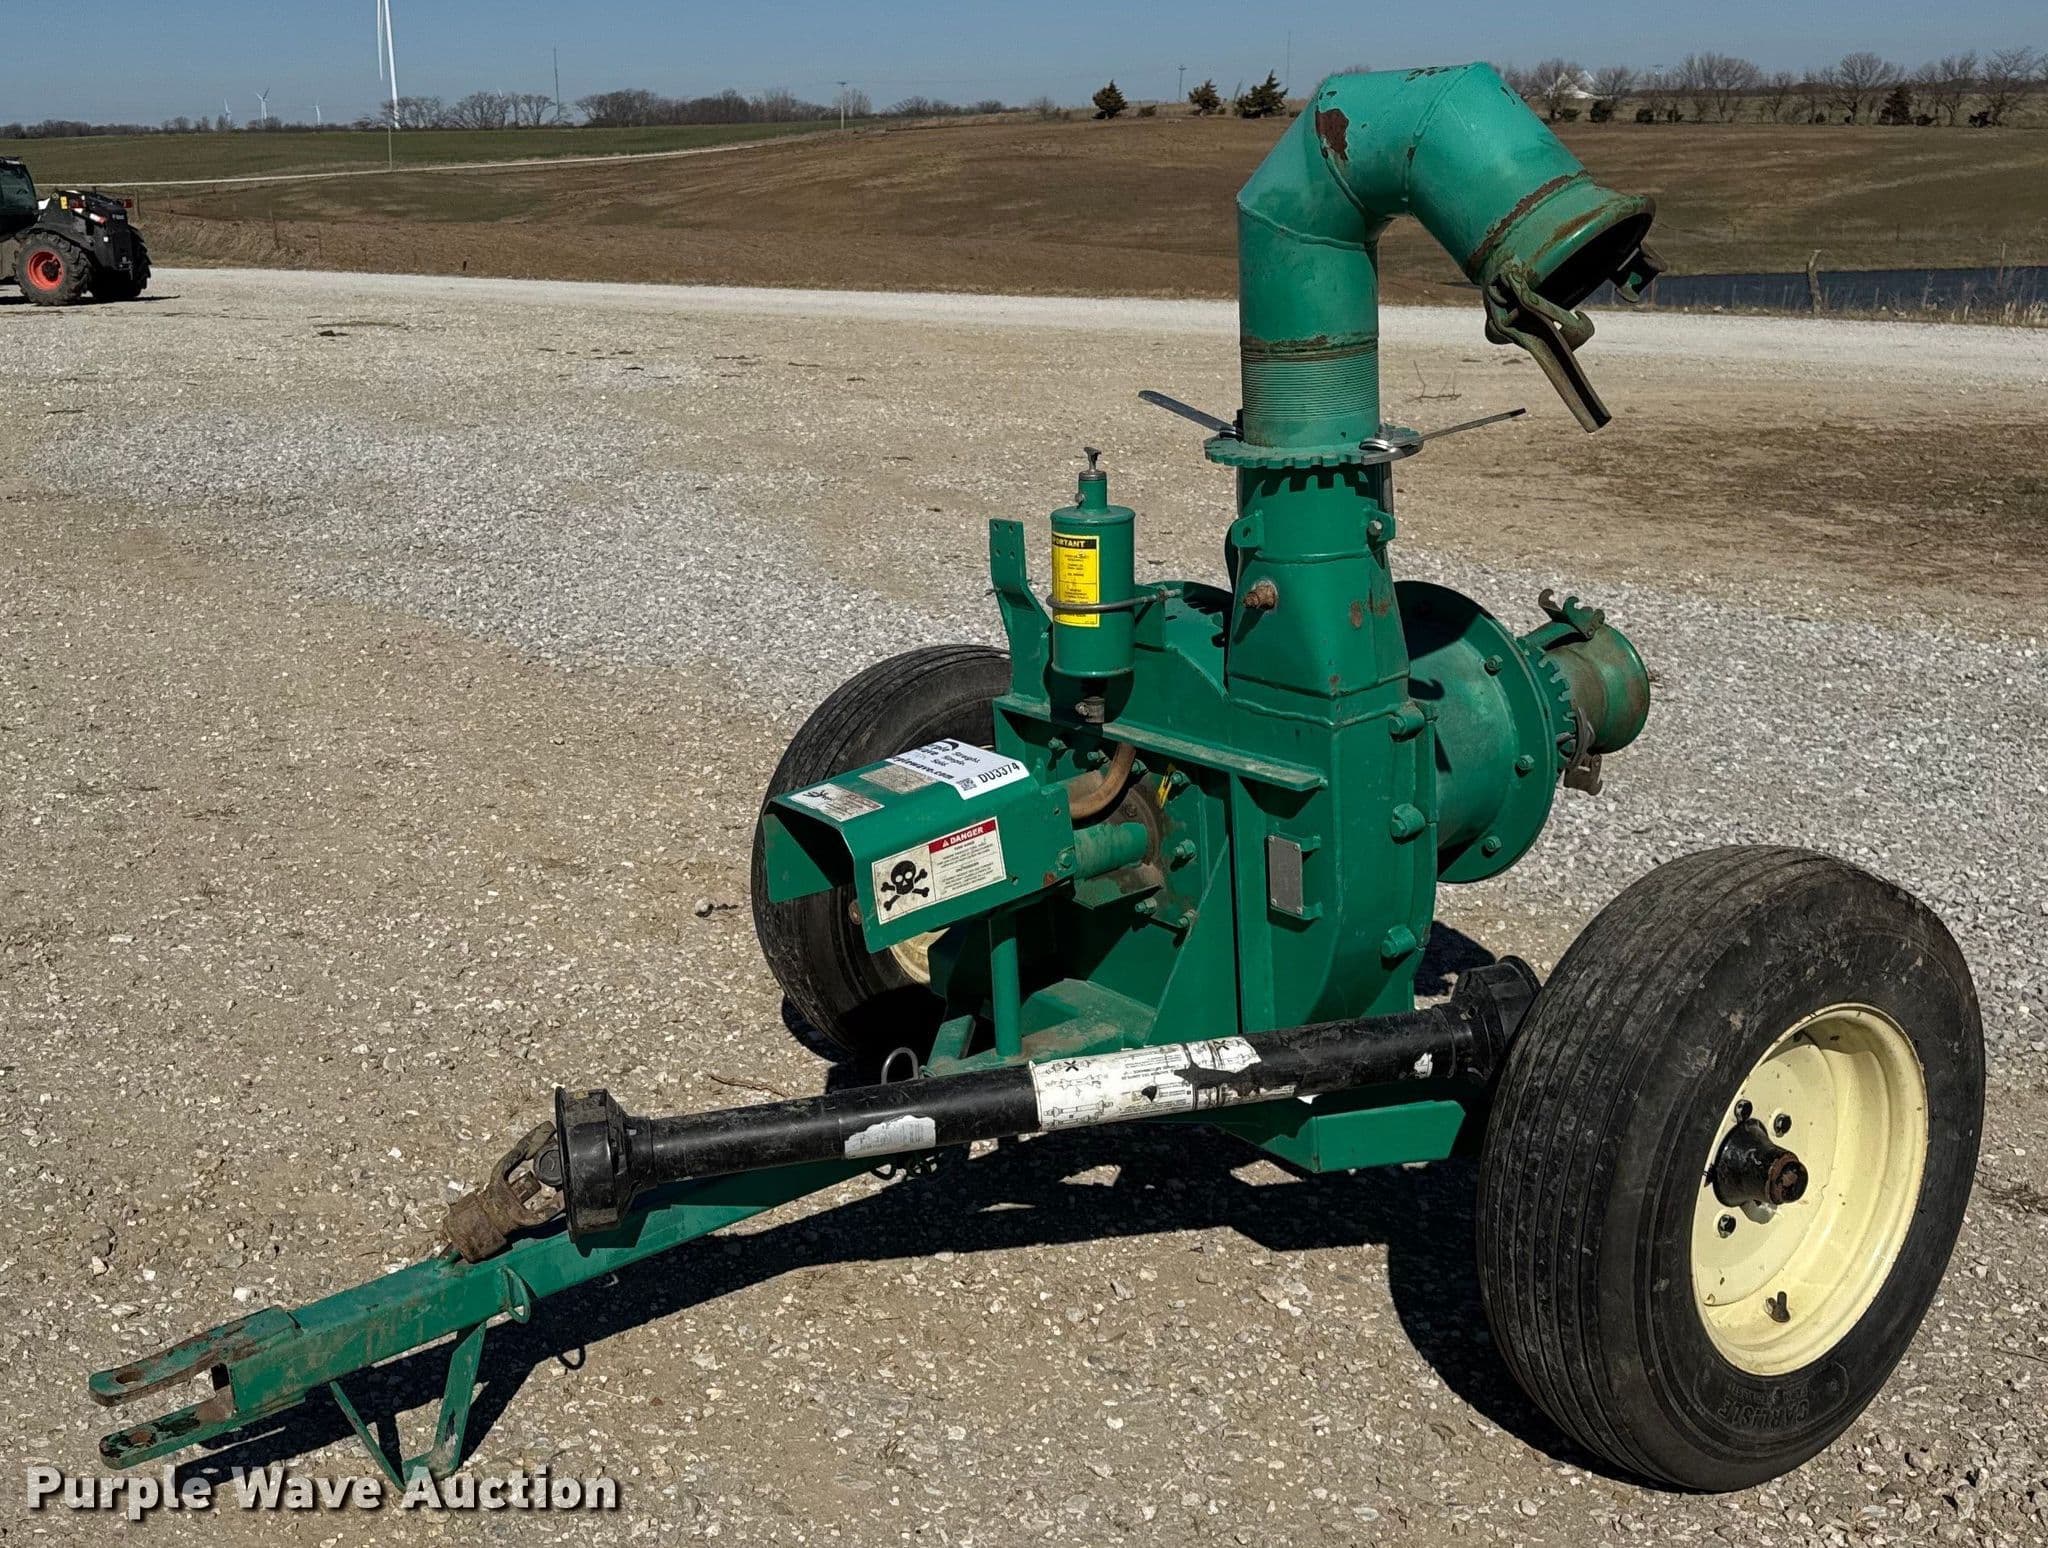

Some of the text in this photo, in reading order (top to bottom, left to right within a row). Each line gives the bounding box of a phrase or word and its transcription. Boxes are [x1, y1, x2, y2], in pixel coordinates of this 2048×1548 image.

[1054, 537, 1086, 548] ORTANT
[977, 762, 1021, 784] DU3374
[950, 826, 984, 844] DANGER
[1718, 1397, 1809, 1429] CARLISLE
